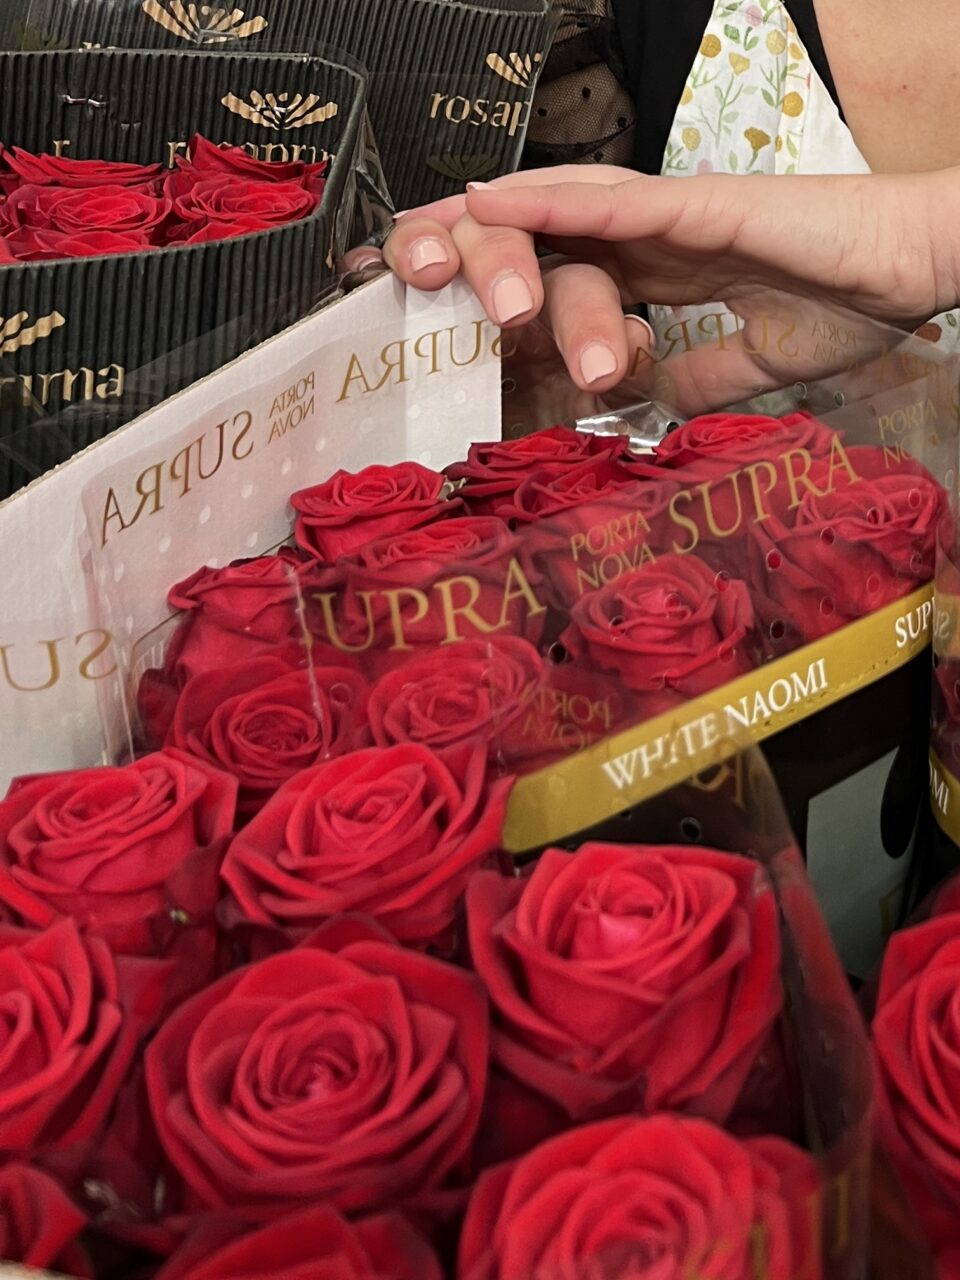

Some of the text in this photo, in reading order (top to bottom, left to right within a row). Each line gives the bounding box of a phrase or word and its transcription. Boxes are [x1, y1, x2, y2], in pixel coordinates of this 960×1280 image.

[570, 510, 652, 562] PORTA
[668, 432, 863, 555] SUPRA
[300, 556, 549, 653] UPRA
[577, 542, 657, 595] NOVA
[602, 713, 717, 790] WHITE
[724, 658, 829, 736] NAOMI
